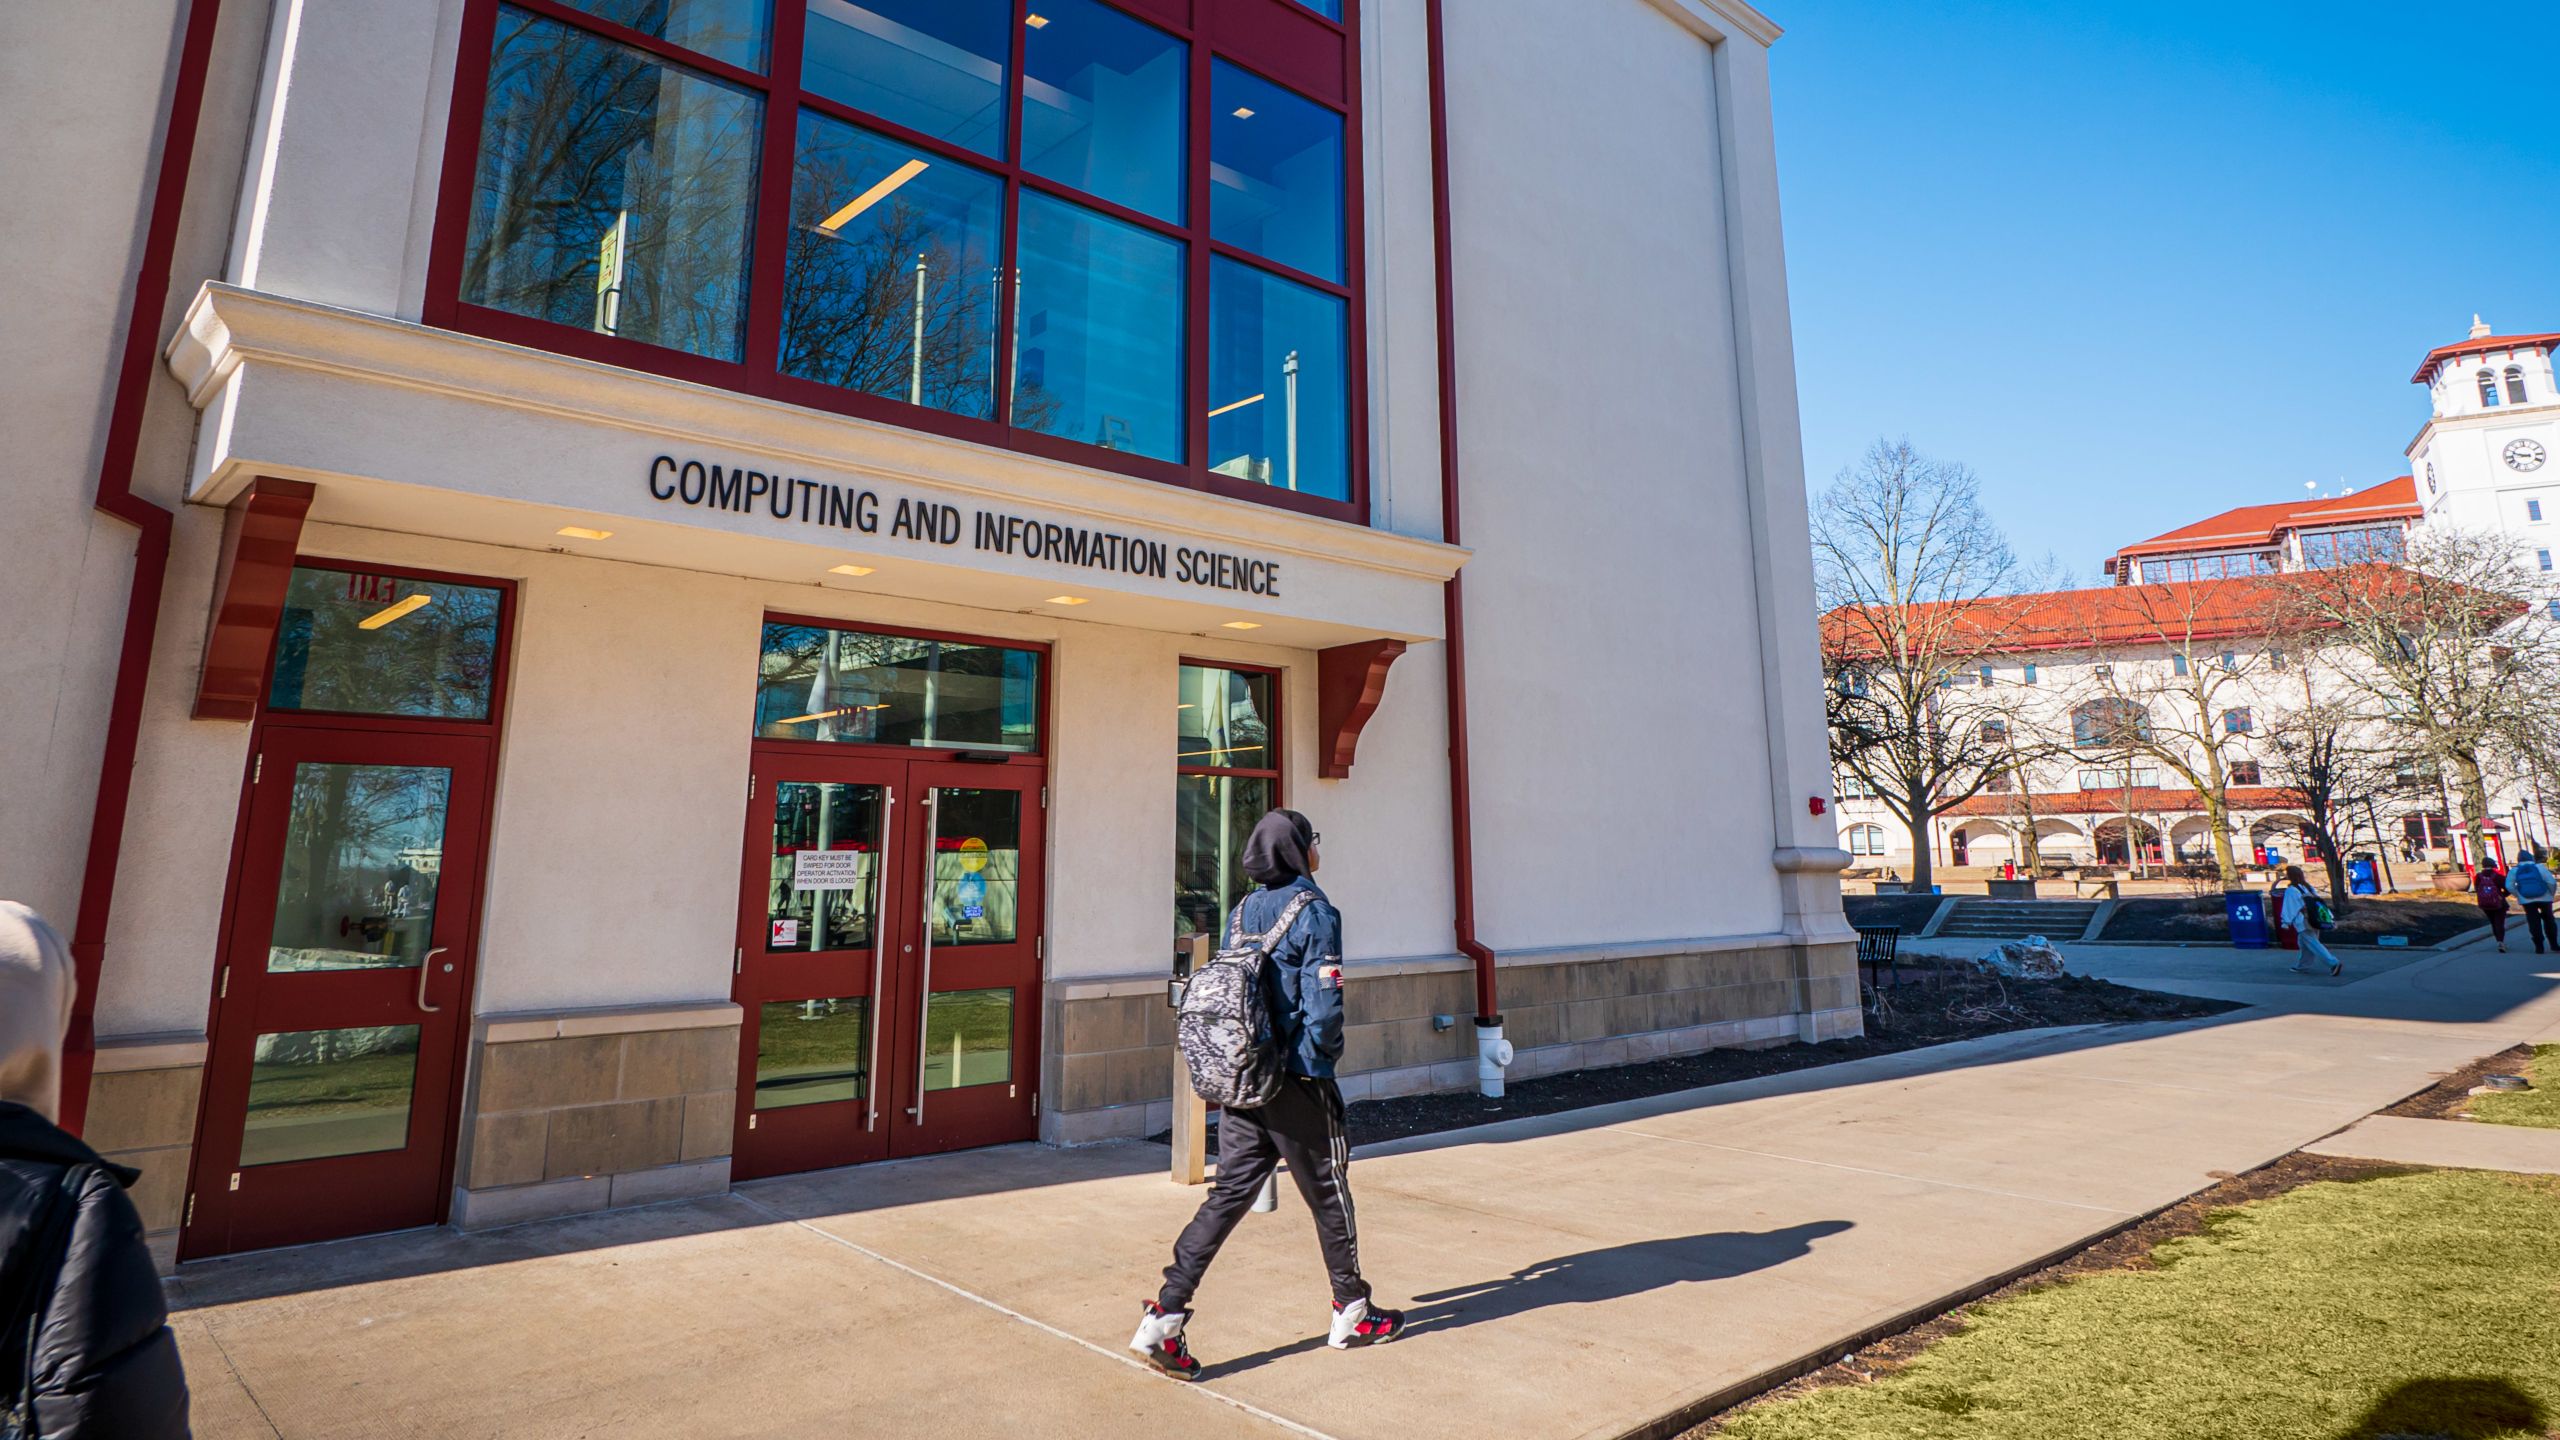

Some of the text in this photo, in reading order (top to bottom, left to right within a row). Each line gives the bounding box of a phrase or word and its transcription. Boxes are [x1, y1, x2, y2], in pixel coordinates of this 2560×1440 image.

[649, 455, 1280, 597] COMPUTING AND INFORMATION SCIENCE
